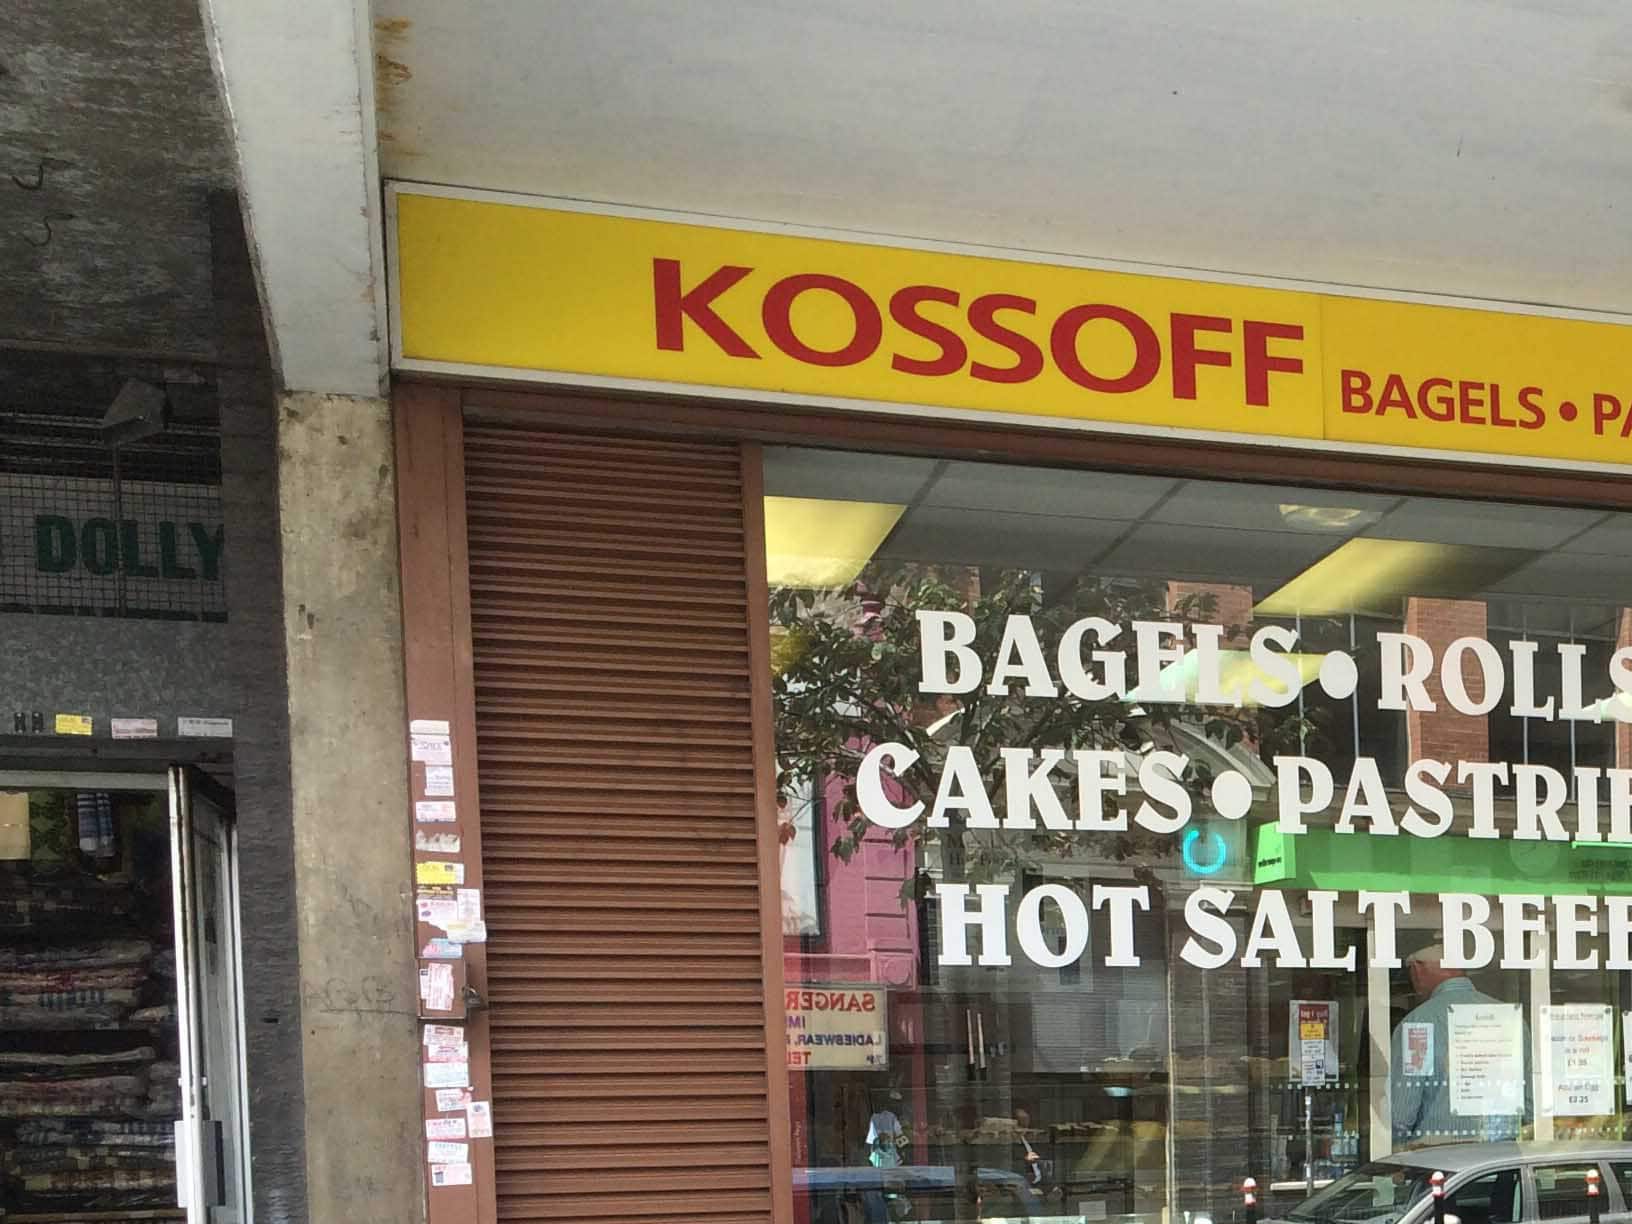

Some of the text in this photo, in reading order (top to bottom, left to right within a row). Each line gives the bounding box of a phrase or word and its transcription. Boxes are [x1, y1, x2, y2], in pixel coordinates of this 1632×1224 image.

[653, 258, 1305, 407] KOSSOFF
[1340, 369, 1546, 430] BAGELS
[35, 514, 225, 581] DOLLY
[915, 610, 1303, 708] BAGELS
[856, 742, 1191, 833] CAKES
[934, 882, 1150, 969] HOT
[1180, 886, 1411, 971] SALT
